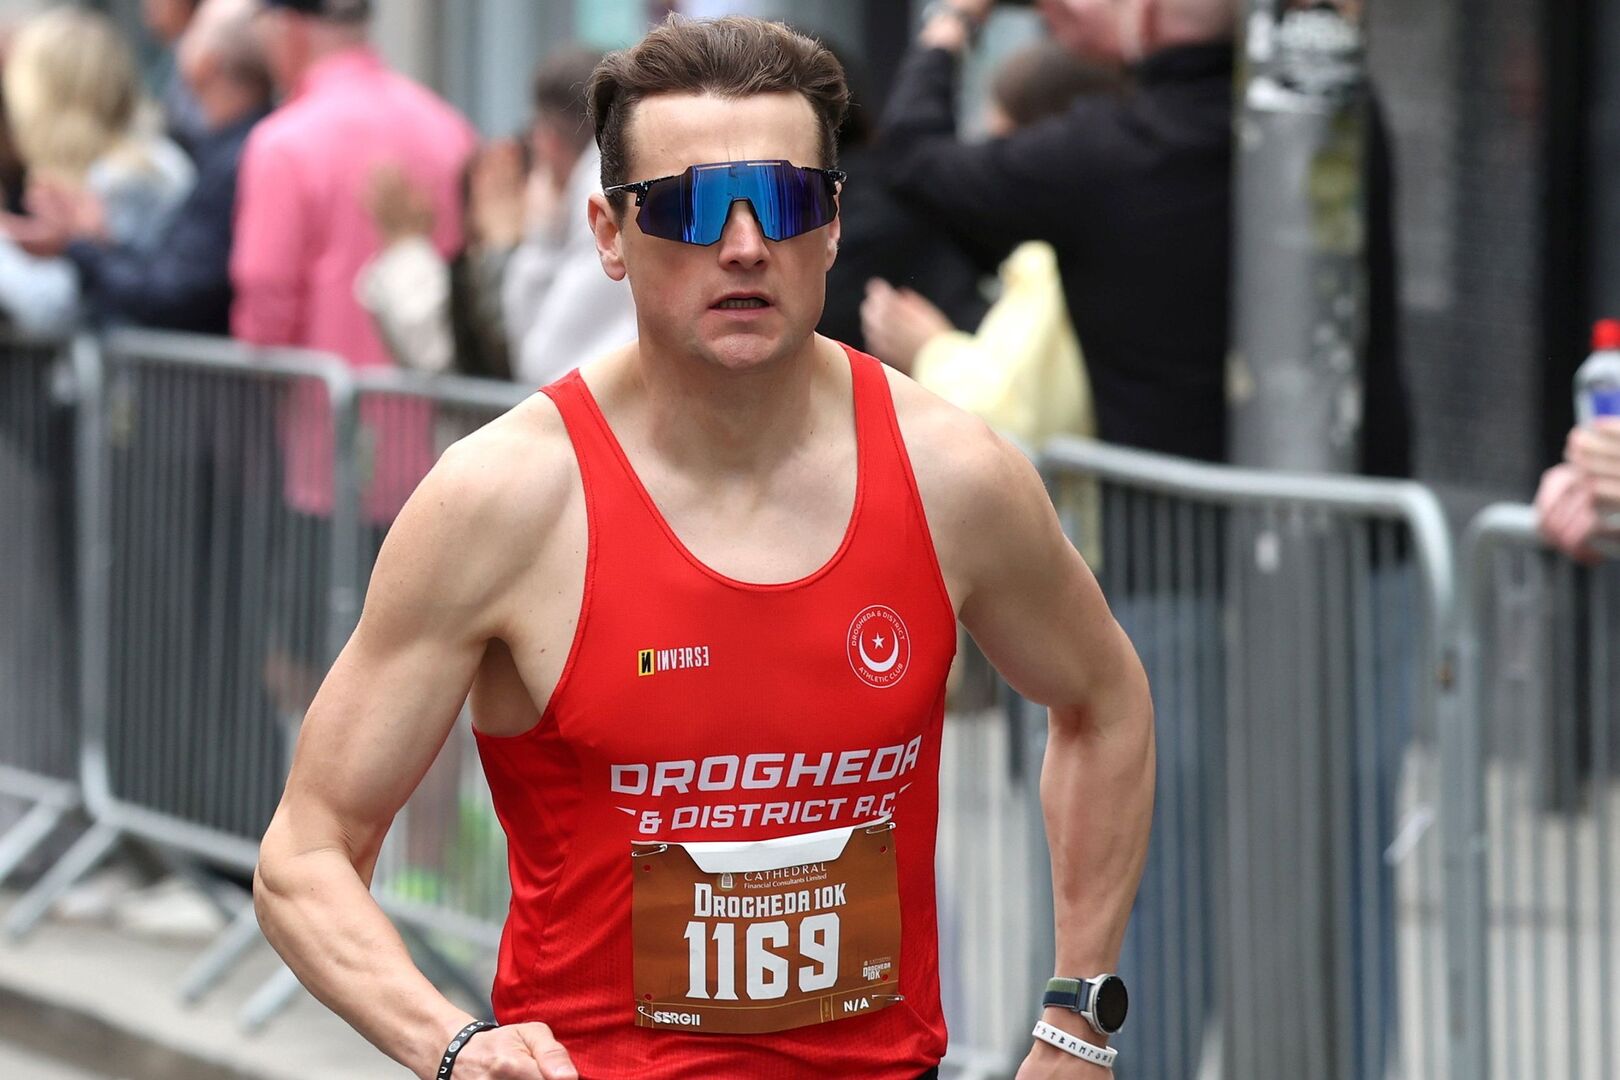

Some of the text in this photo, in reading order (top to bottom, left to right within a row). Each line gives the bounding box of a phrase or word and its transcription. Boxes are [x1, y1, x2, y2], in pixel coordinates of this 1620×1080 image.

[852, 611, 876, 647] DROGHEDA
[882, 612, 905, 640] DISTRICT
[859, 663, 904, 682] ATHLETIC CLUB
[611, 735, 922, 797] DROGHEDA
[639, 811, 663, 834] &
[671, 798, 848, 831] DISTRICT
[744, 863, 827, 881] CATHEDRAL
[772, 878, 805, 887] Consultants
[806, 873, 827, 881] Limited
[814, 883, 847, 910] 10K
[683, 912, 840, 1000] 1169
[654, 1011, 700, 1026] SERGII
[844, 997, 869, 1012] N/A
